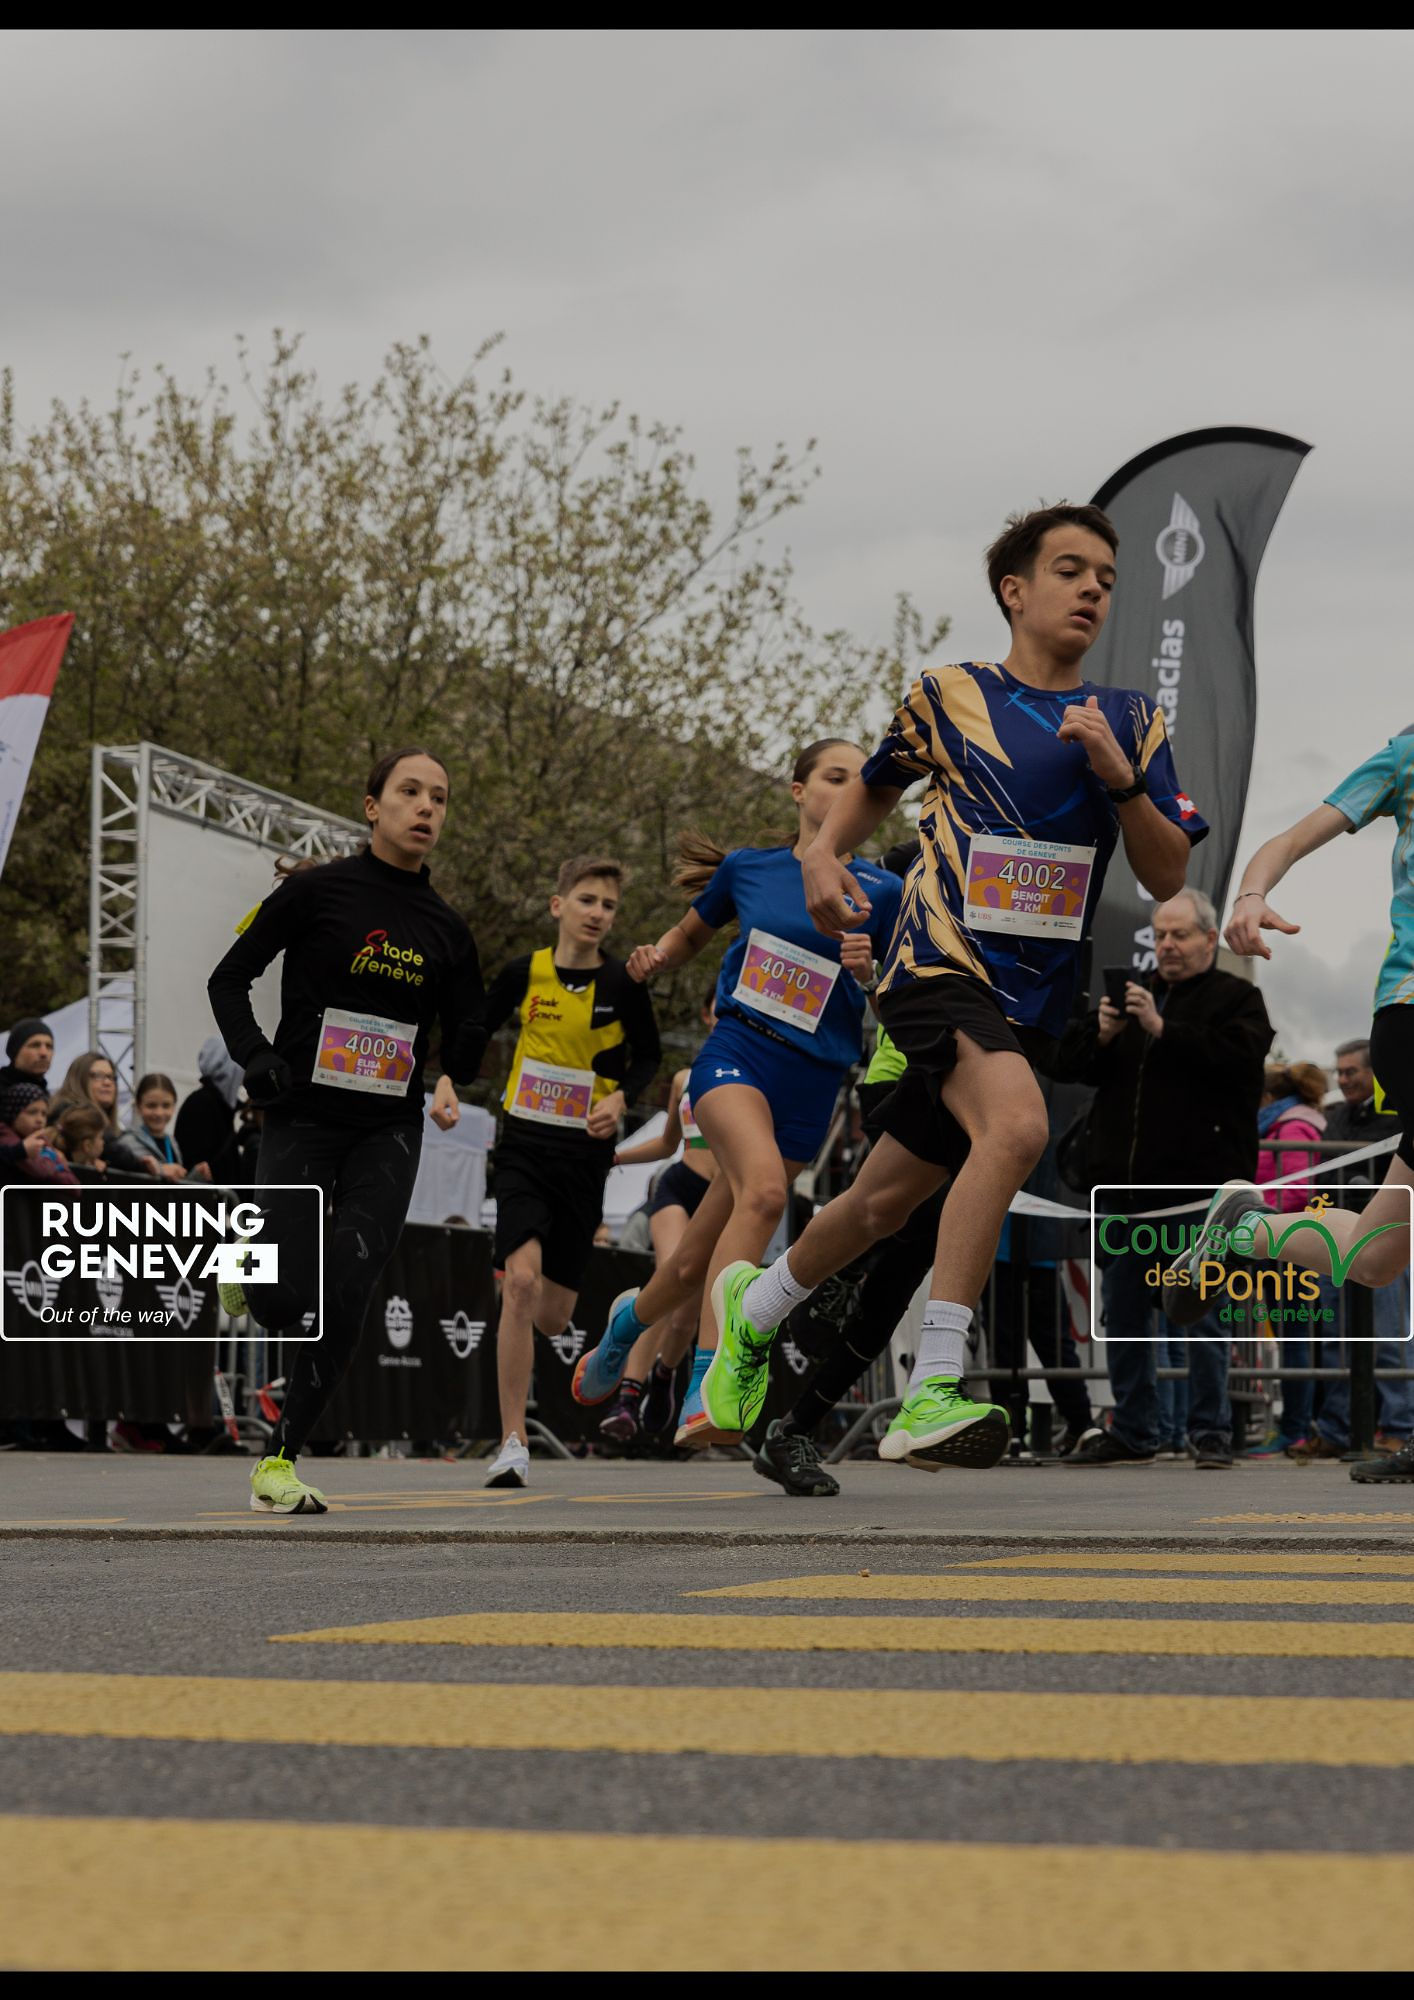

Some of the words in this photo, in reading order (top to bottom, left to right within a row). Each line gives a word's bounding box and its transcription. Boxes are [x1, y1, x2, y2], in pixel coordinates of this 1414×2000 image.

[1002, 838, 1032, 848] COURSE
[1034, 842, 1048, 850] DES
[1049, 844, 1072, 853] PONTS
[998, 860, 1066, 891] 4002
[1011, 890, 1050, 903] BENOIT
[1014, 902, 1022, 911] 2
[1024, 903, 1041, 914] KM
[977, 912, 992, 921] UBS
[357, 929, 424, 966] Stade
[350, 946, 424, 986] Genève
[760, 957, 810, 990] 4010
[762, 988, 769, 997] 2
[770, 991, 785, 1003] KM
[345, 1033, 398, 1061] 4009
[356, 1058, 381, 1070] ELISA
[355, 1067, 363, 1075] 2
[363, 1068, 378, 1079] KM
[532, 1079, 574, 1100] 4007
